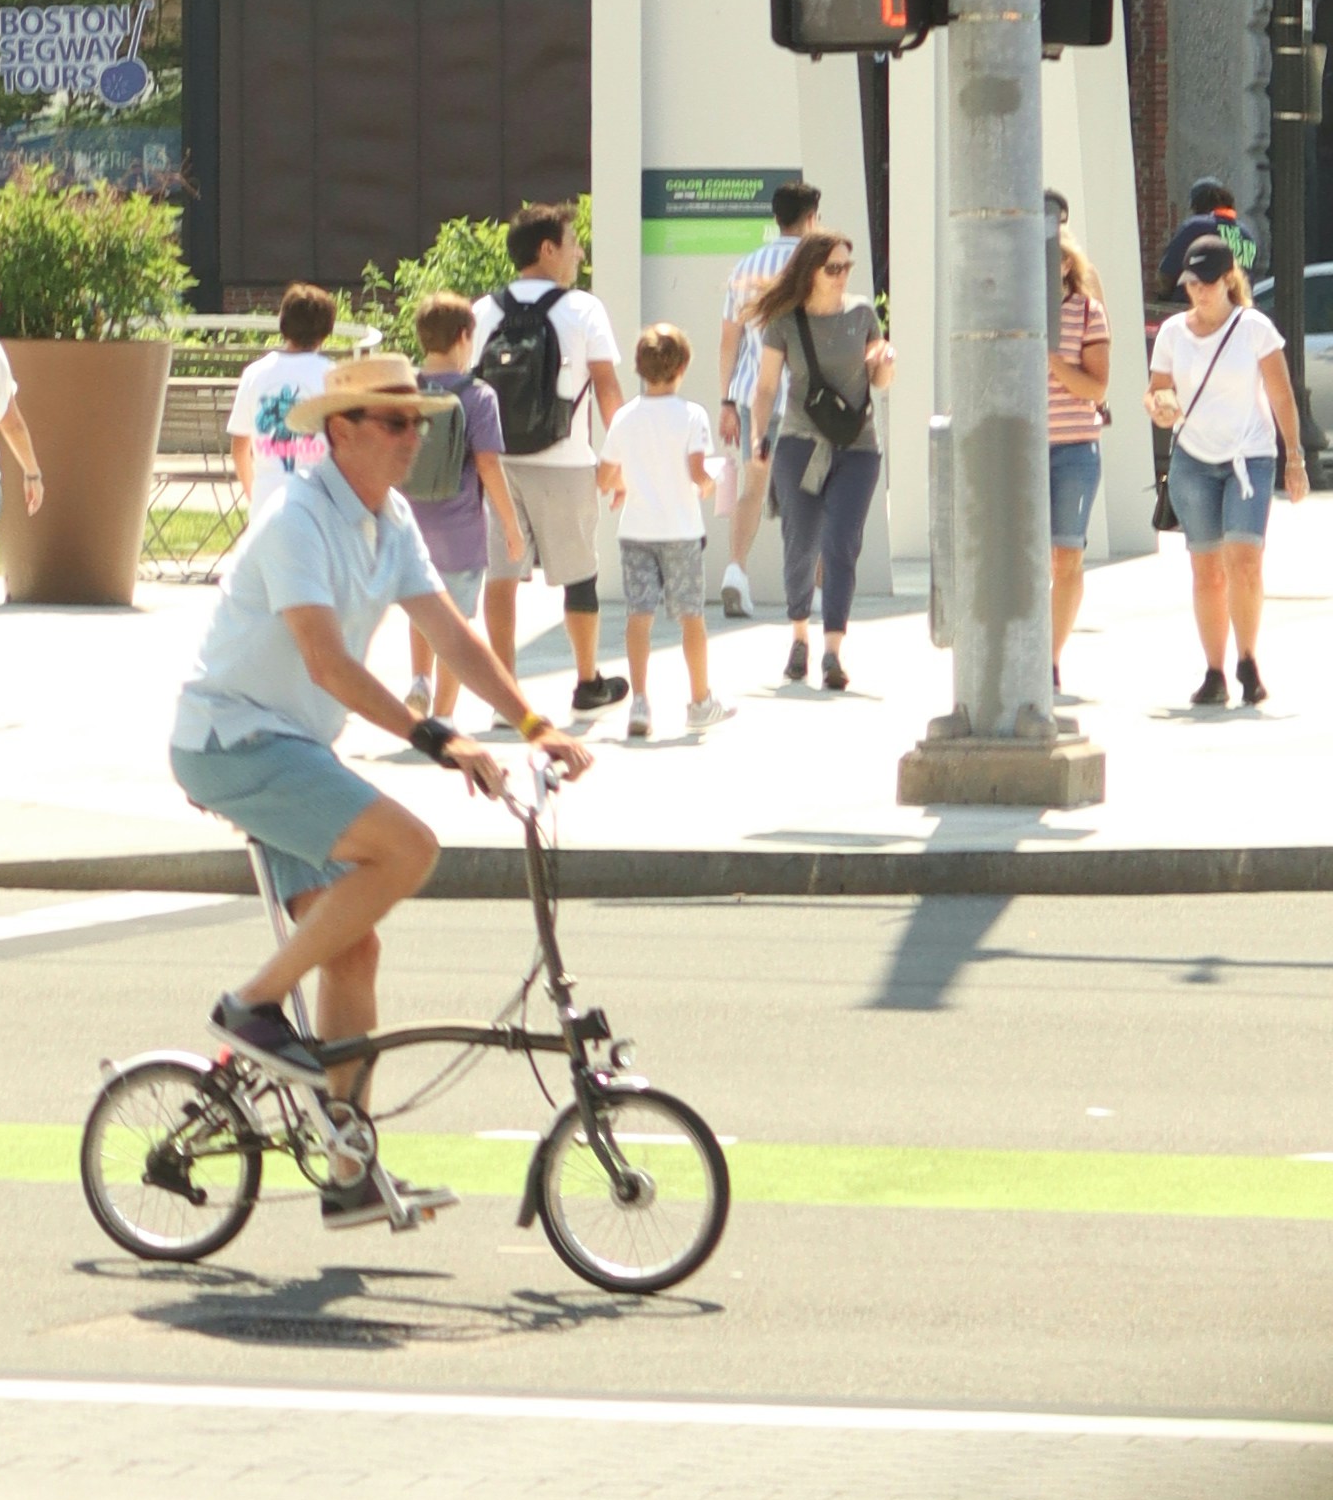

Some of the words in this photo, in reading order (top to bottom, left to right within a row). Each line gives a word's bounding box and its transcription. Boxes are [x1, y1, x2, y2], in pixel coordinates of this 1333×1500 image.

[0, 6, 129, 35] BOSTON
[0, 36, 121, 62] SEGWAY
[1, 65, 96, 91] TOURS
